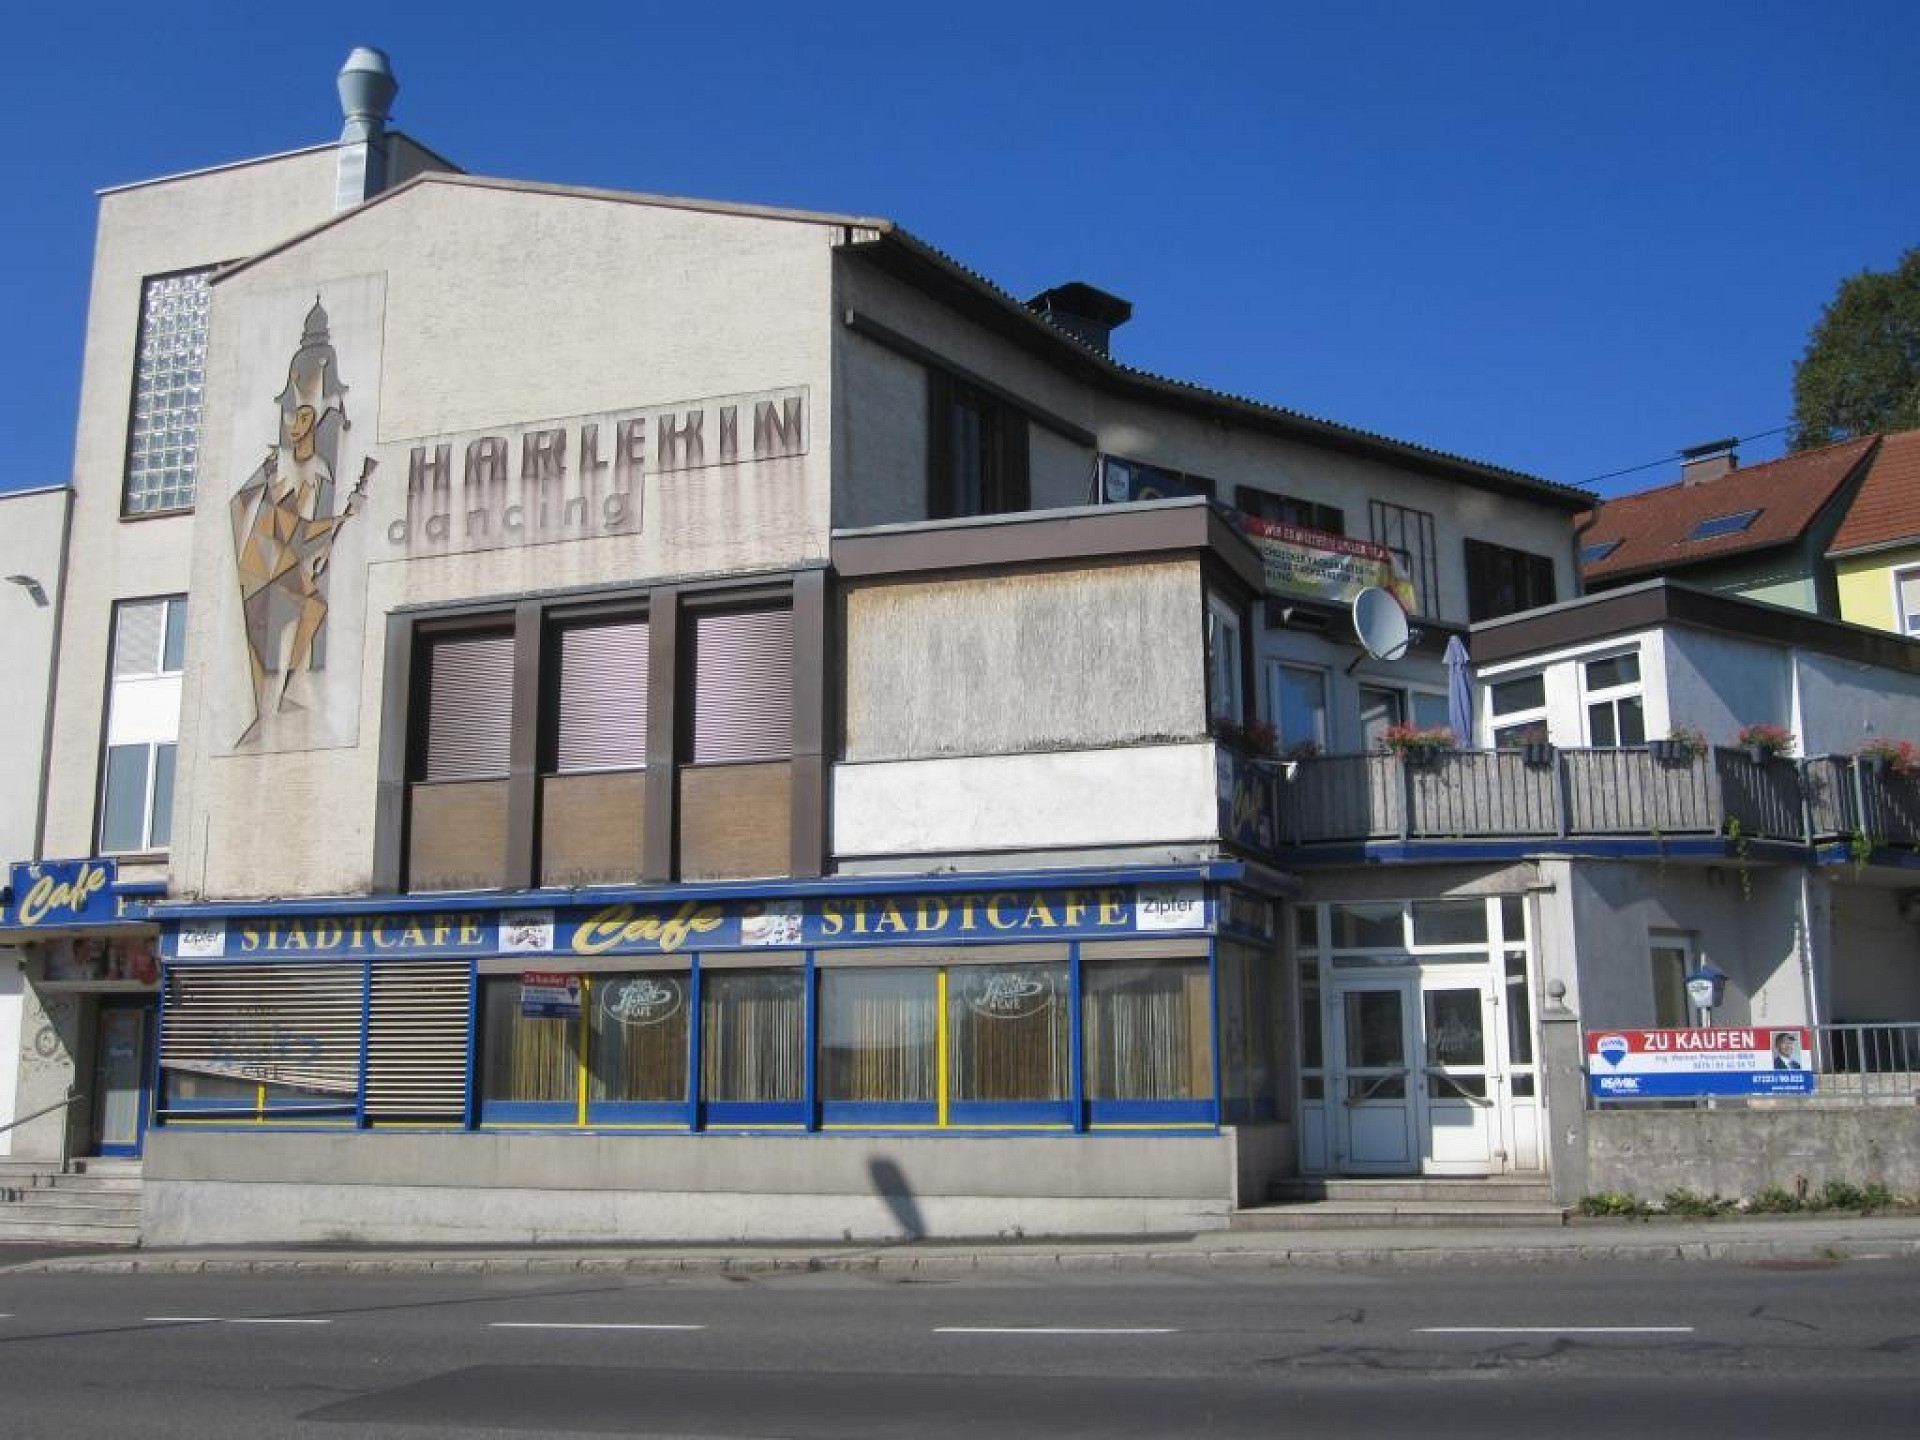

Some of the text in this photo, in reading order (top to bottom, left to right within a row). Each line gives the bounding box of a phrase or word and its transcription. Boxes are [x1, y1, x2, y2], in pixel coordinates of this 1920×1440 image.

[408, 397, 802, 492] HARLEKIN
[388, 479, 630, 545] dancing
[821, 889, 1128, 935] STADTCAFE
[1143, 895, 1195, 916] Zipfer
[241, 913, 483, 952] STADTCAFE
[1643, 1032, 1668, 1051] ZU
[1675, 1031, 1754, 1050] KAUFEN
